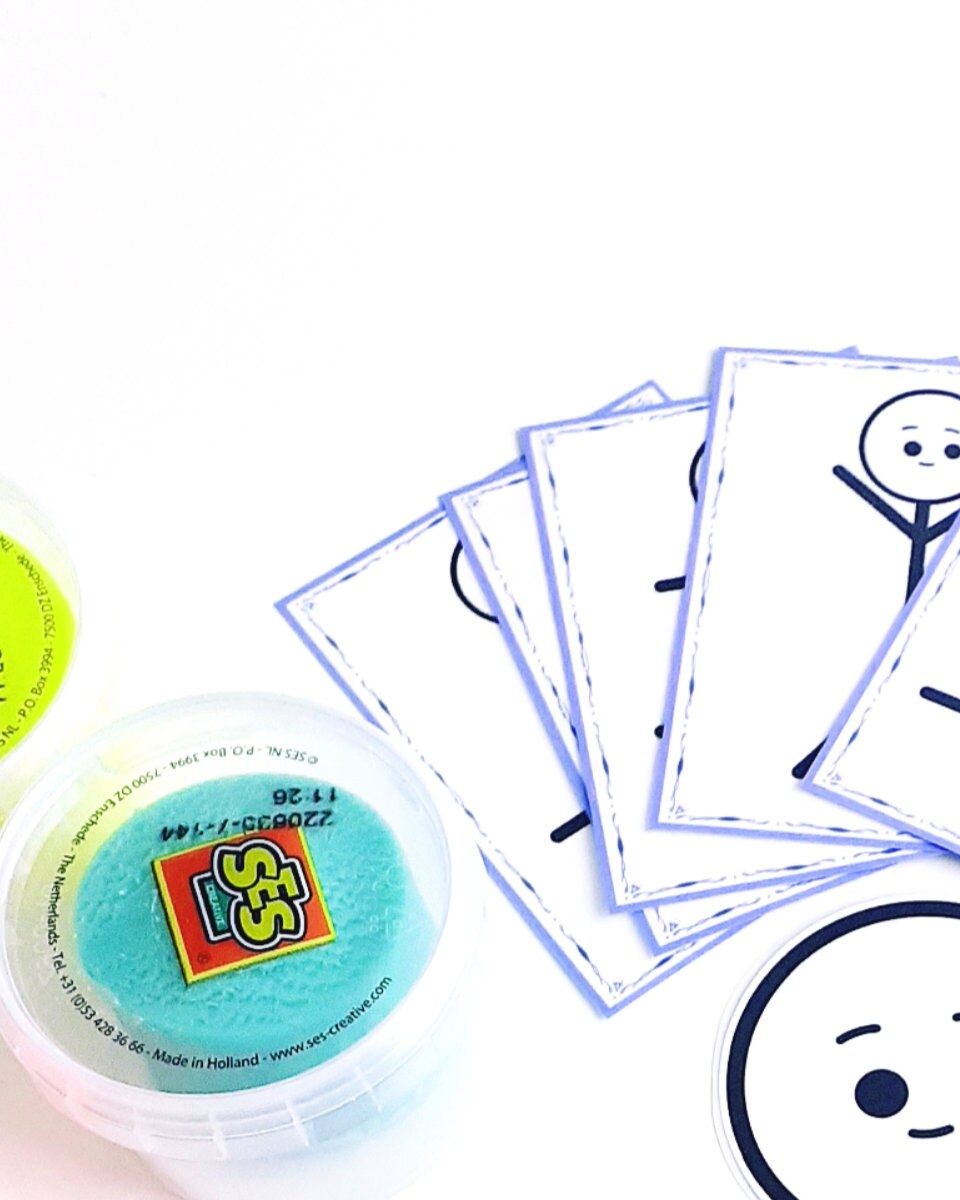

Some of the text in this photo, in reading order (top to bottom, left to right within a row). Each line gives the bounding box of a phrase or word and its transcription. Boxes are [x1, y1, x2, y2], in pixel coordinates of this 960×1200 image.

[204, 747, 227, 758] Box
[266, 745, 282, 757] NL
[284, 749, 305, 762] SES
[170, 753, 199, 769] 3994
[132, 768, 161, 788] 7500
[114, 785, 132, 801] DZ
[72, 799, 116, 846] Enschede
[57, 854, 75, 874] The
[221, 847, 299, 942] SES
[47, 876, 66, 945] Netherlands
[60, 975, 77, 994] +31
[70, 993, 97, 1020] (0)53
[94, 1018, 115, 1037] 428
[270, 975, 393, 1062] www.ses-creative.com
[112, 1031, 129, 1046] 36
[128, 1040, 145, 1054] 66
[152, 1048, 188, 1068] Made
[191, 1057, 203, 1069] in
[207, 1053, 259, 1070] Holland
